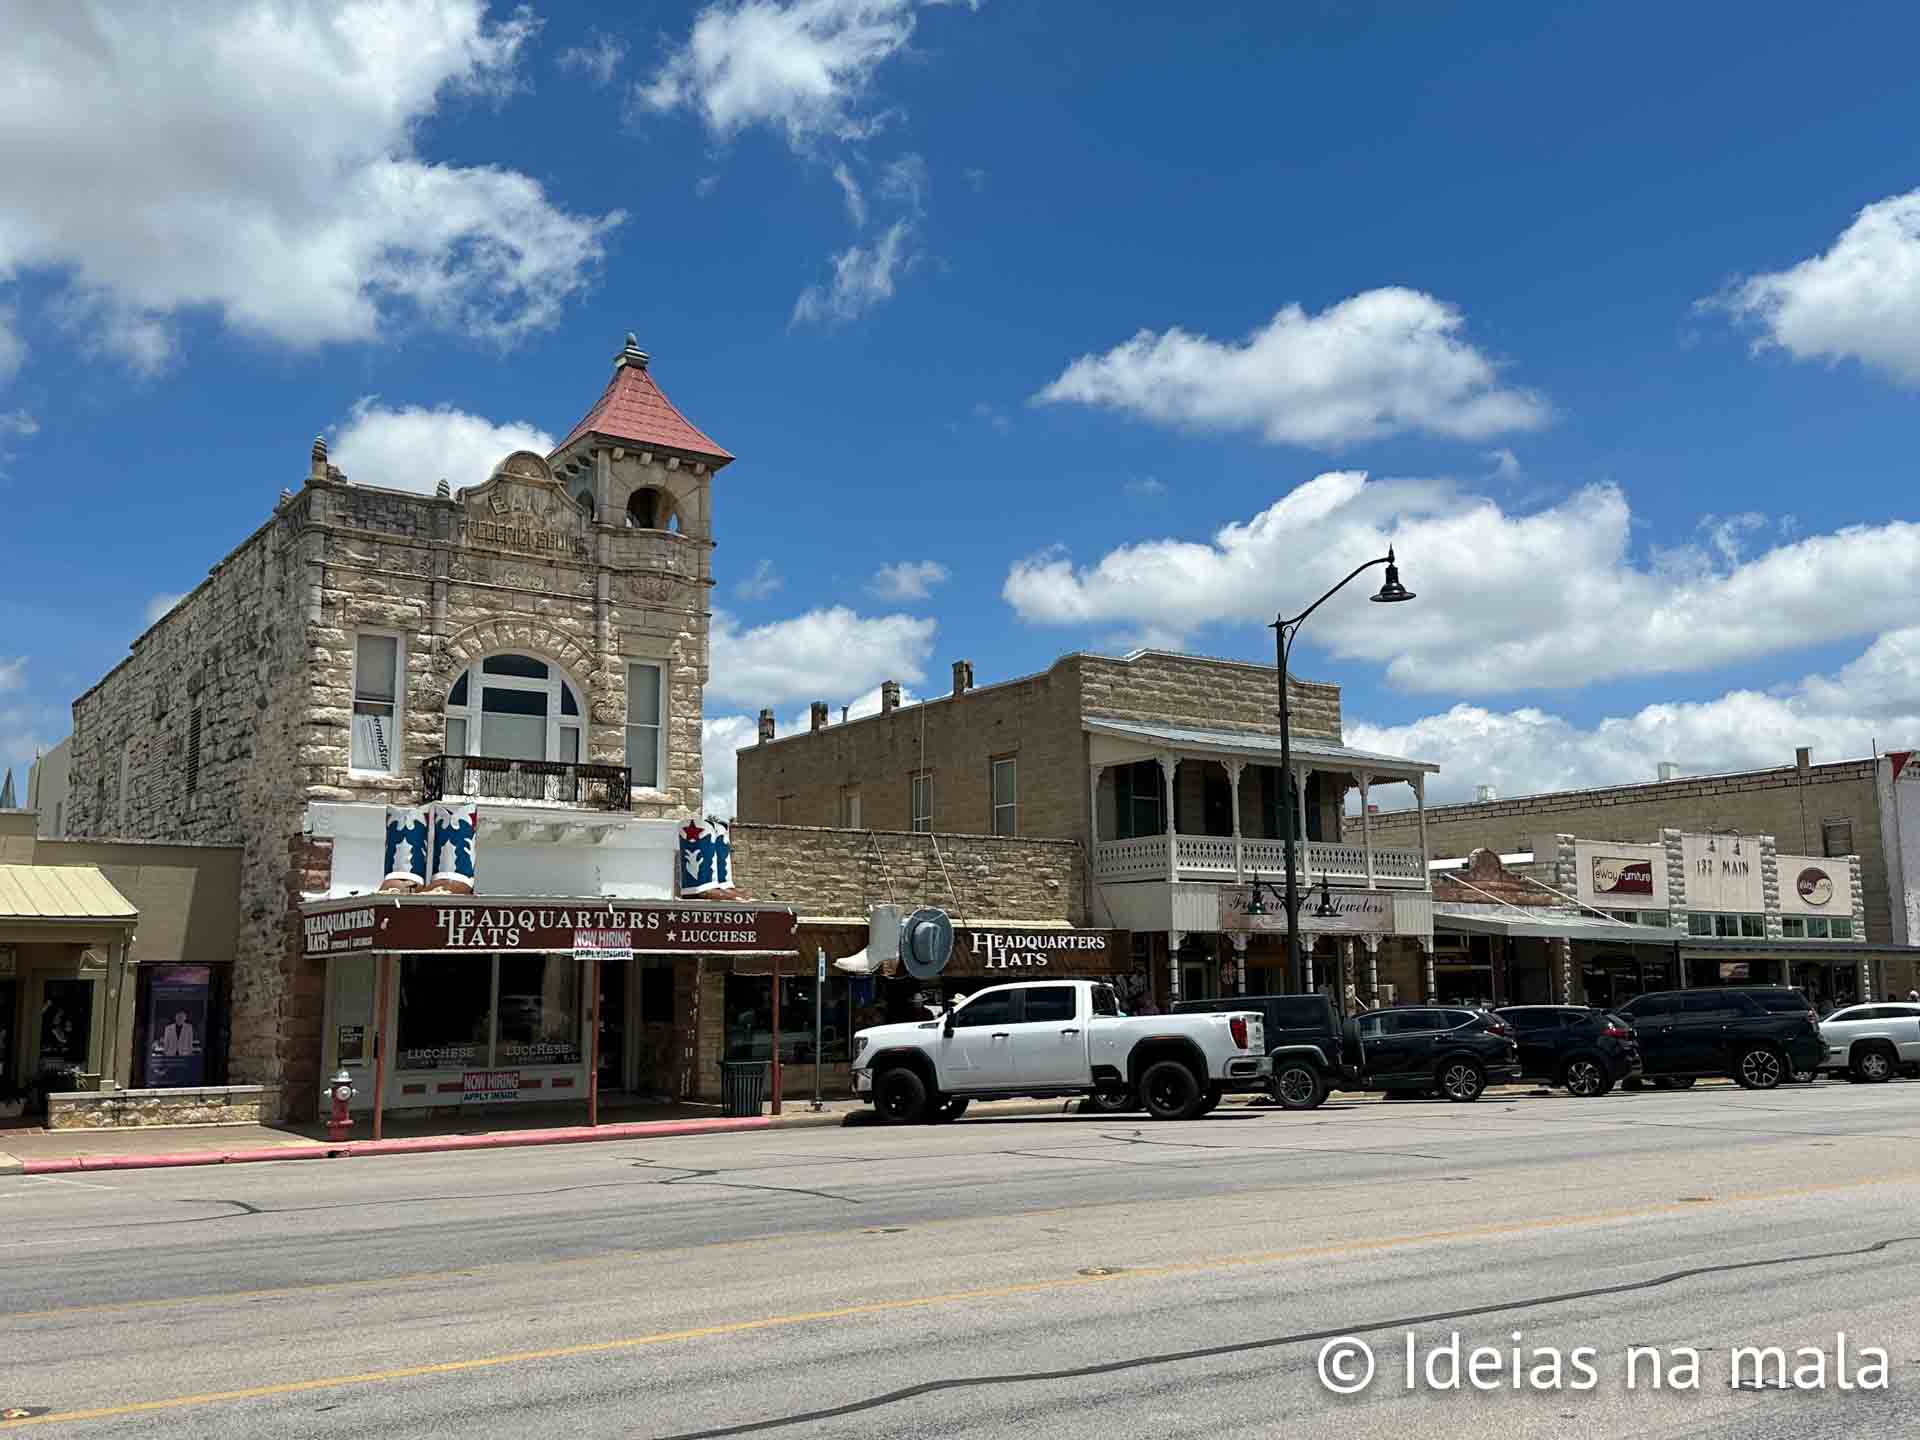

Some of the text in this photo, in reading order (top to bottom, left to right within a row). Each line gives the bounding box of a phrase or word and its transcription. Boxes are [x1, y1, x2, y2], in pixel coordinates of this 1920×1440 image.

[1722, 860, 1749, 876] MAIN
[1331, 895, 1384, 912] Jewelers
[304, 909, 375, 936] HEADQUARTERS
[436, 909, 755, 931] HEADQUARTERS STETSON
[307, 932, 328, 953] HATS
[446, 927, 520, 946] HATS
[574, 930, 632, 947] NOW HIRING
[680, 930, 757, 943] LUCCHESE
[970, 932, 1106, 953] HEADQUARTERS
[575, 950, 601, 959] APPLY
[985, 948, 1048, 968] HATS
[407, 1047, 476, 1060] LUCCHESE
[503, 1043, 569, 1056] LUCCHESE
[464, 1073, 520, 1089] NOW HIRING
